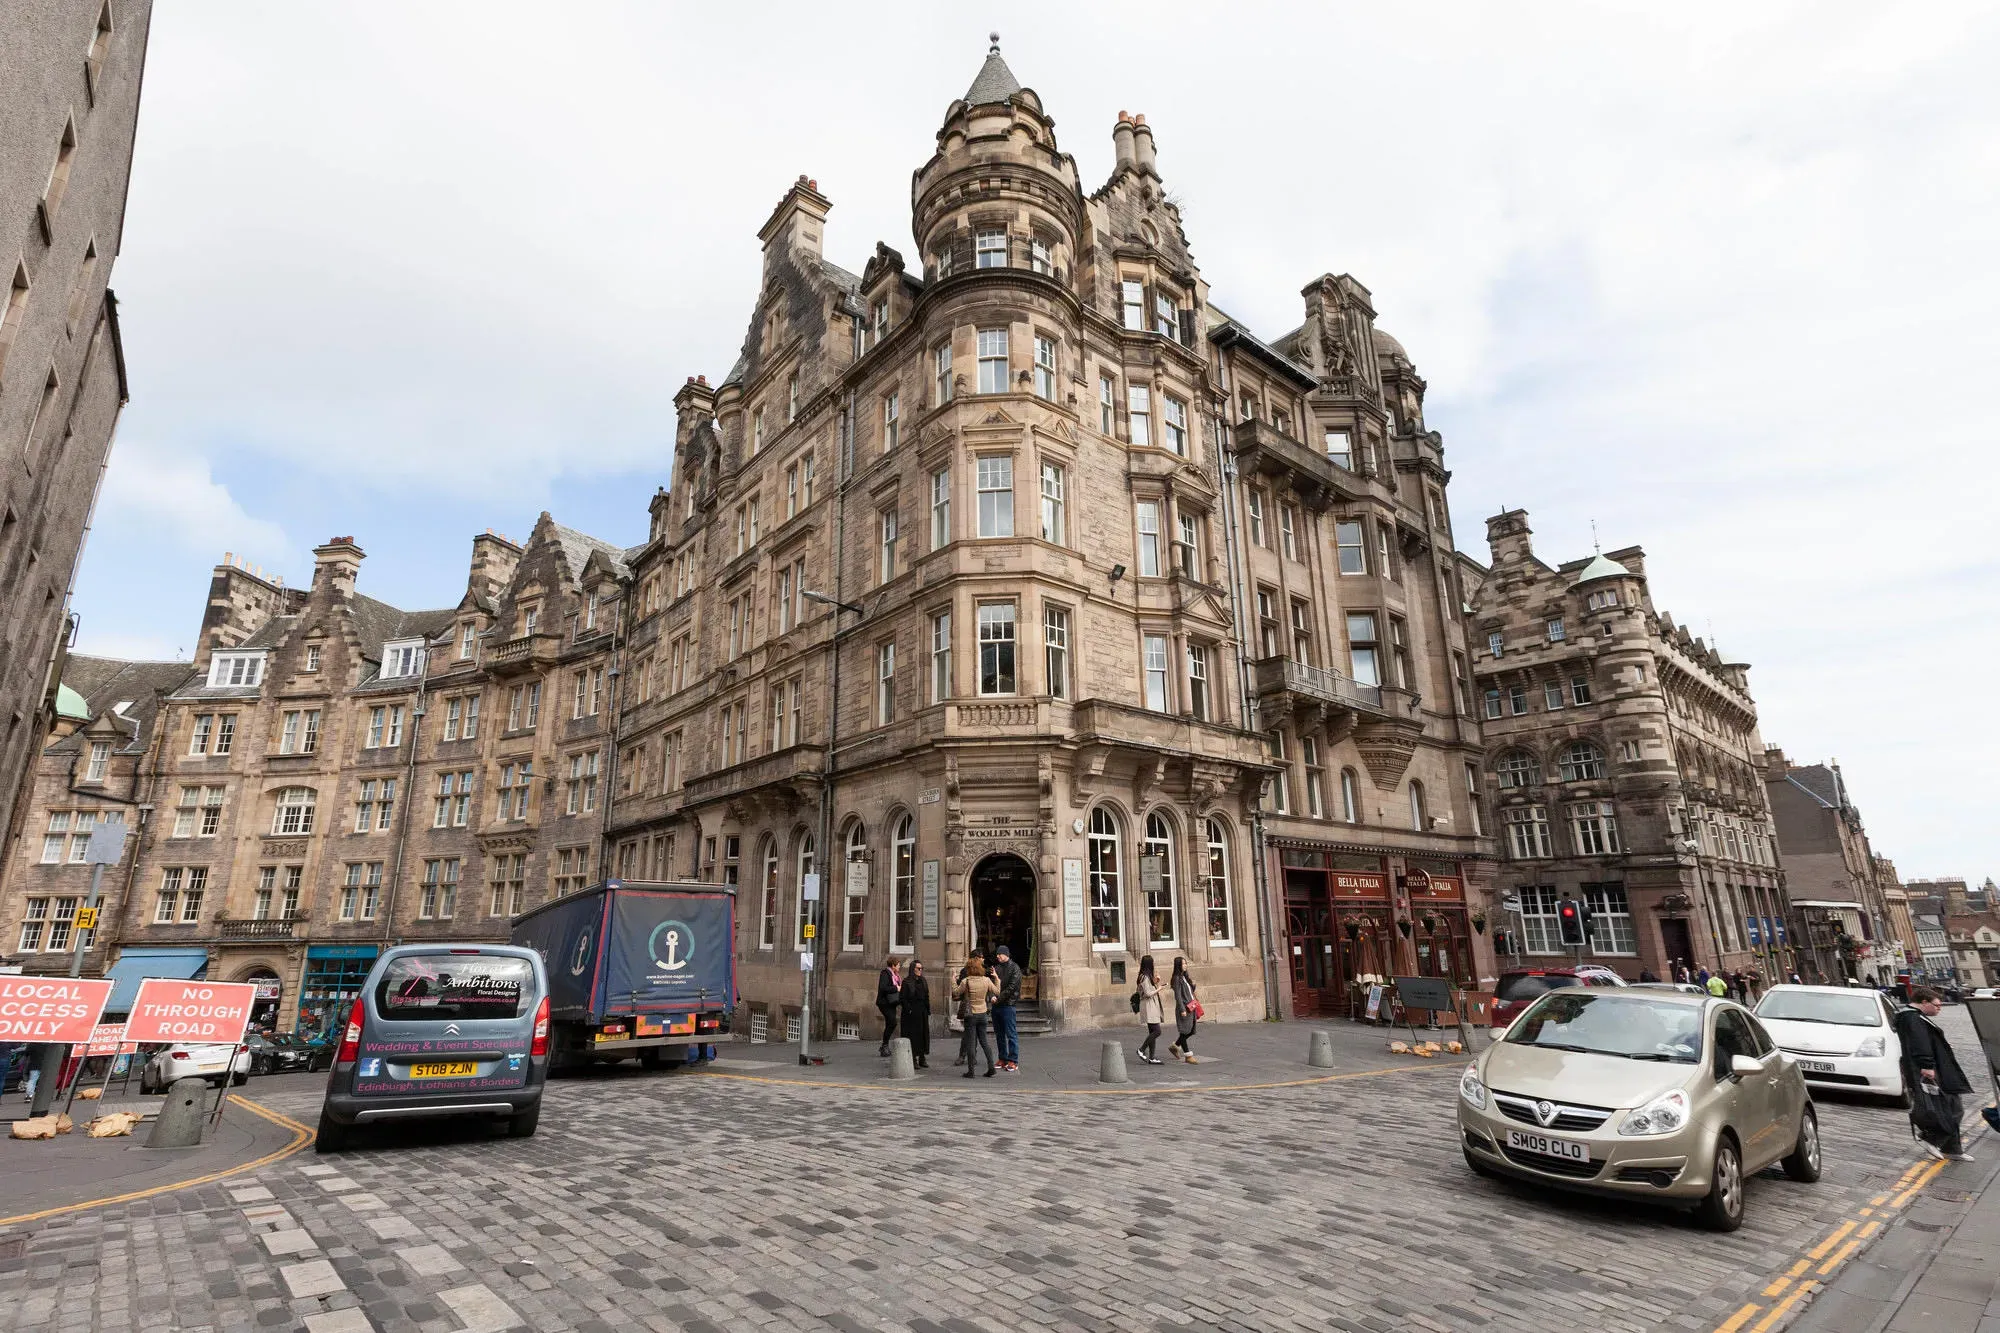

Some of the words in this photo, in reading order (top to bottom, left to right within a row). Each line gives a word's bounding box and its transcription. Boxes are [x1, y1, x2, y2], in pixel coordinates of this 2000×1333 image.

[992, 816, 1011, 824] THE
[1014, 829, 1035, 837] MILL
[1338, 877, 1358, 888] BELLA
[1360, 878, 1379, 888] ITALIA
[1434, 882, 1452, 890] ITALIA
[442, 976, 519, 989] Ambitions
[2, 984, 82, 1000] LOCAL
[182, 988, 213, 1000] NO
[0, 1002, 88, 1018] CCESS
[144, 1004, 241, 1018] THROUGH
[95, 1027, 125, 1035] ROAD
[158, 1022, 216, 1036] ROAD
[366, 1042, 419, 1052] Wedding
[422, 1041, 432, 1050] &
[436, 1040, 469, 1050] Event
[472, 1039, 526, 1049] Specialist
[416, 1063, 447, 1076] ST08
[449, 1062, 473, 1074] ZJN
[420, 1080, 466, 1090] Lothians
[469, 1079, 477, 1088] &
[480, 1077, 520, 1087] Borders
[1512, 1132, 1547, 1152] SM09
[1552, 1141, 1581, 1158] CLO
